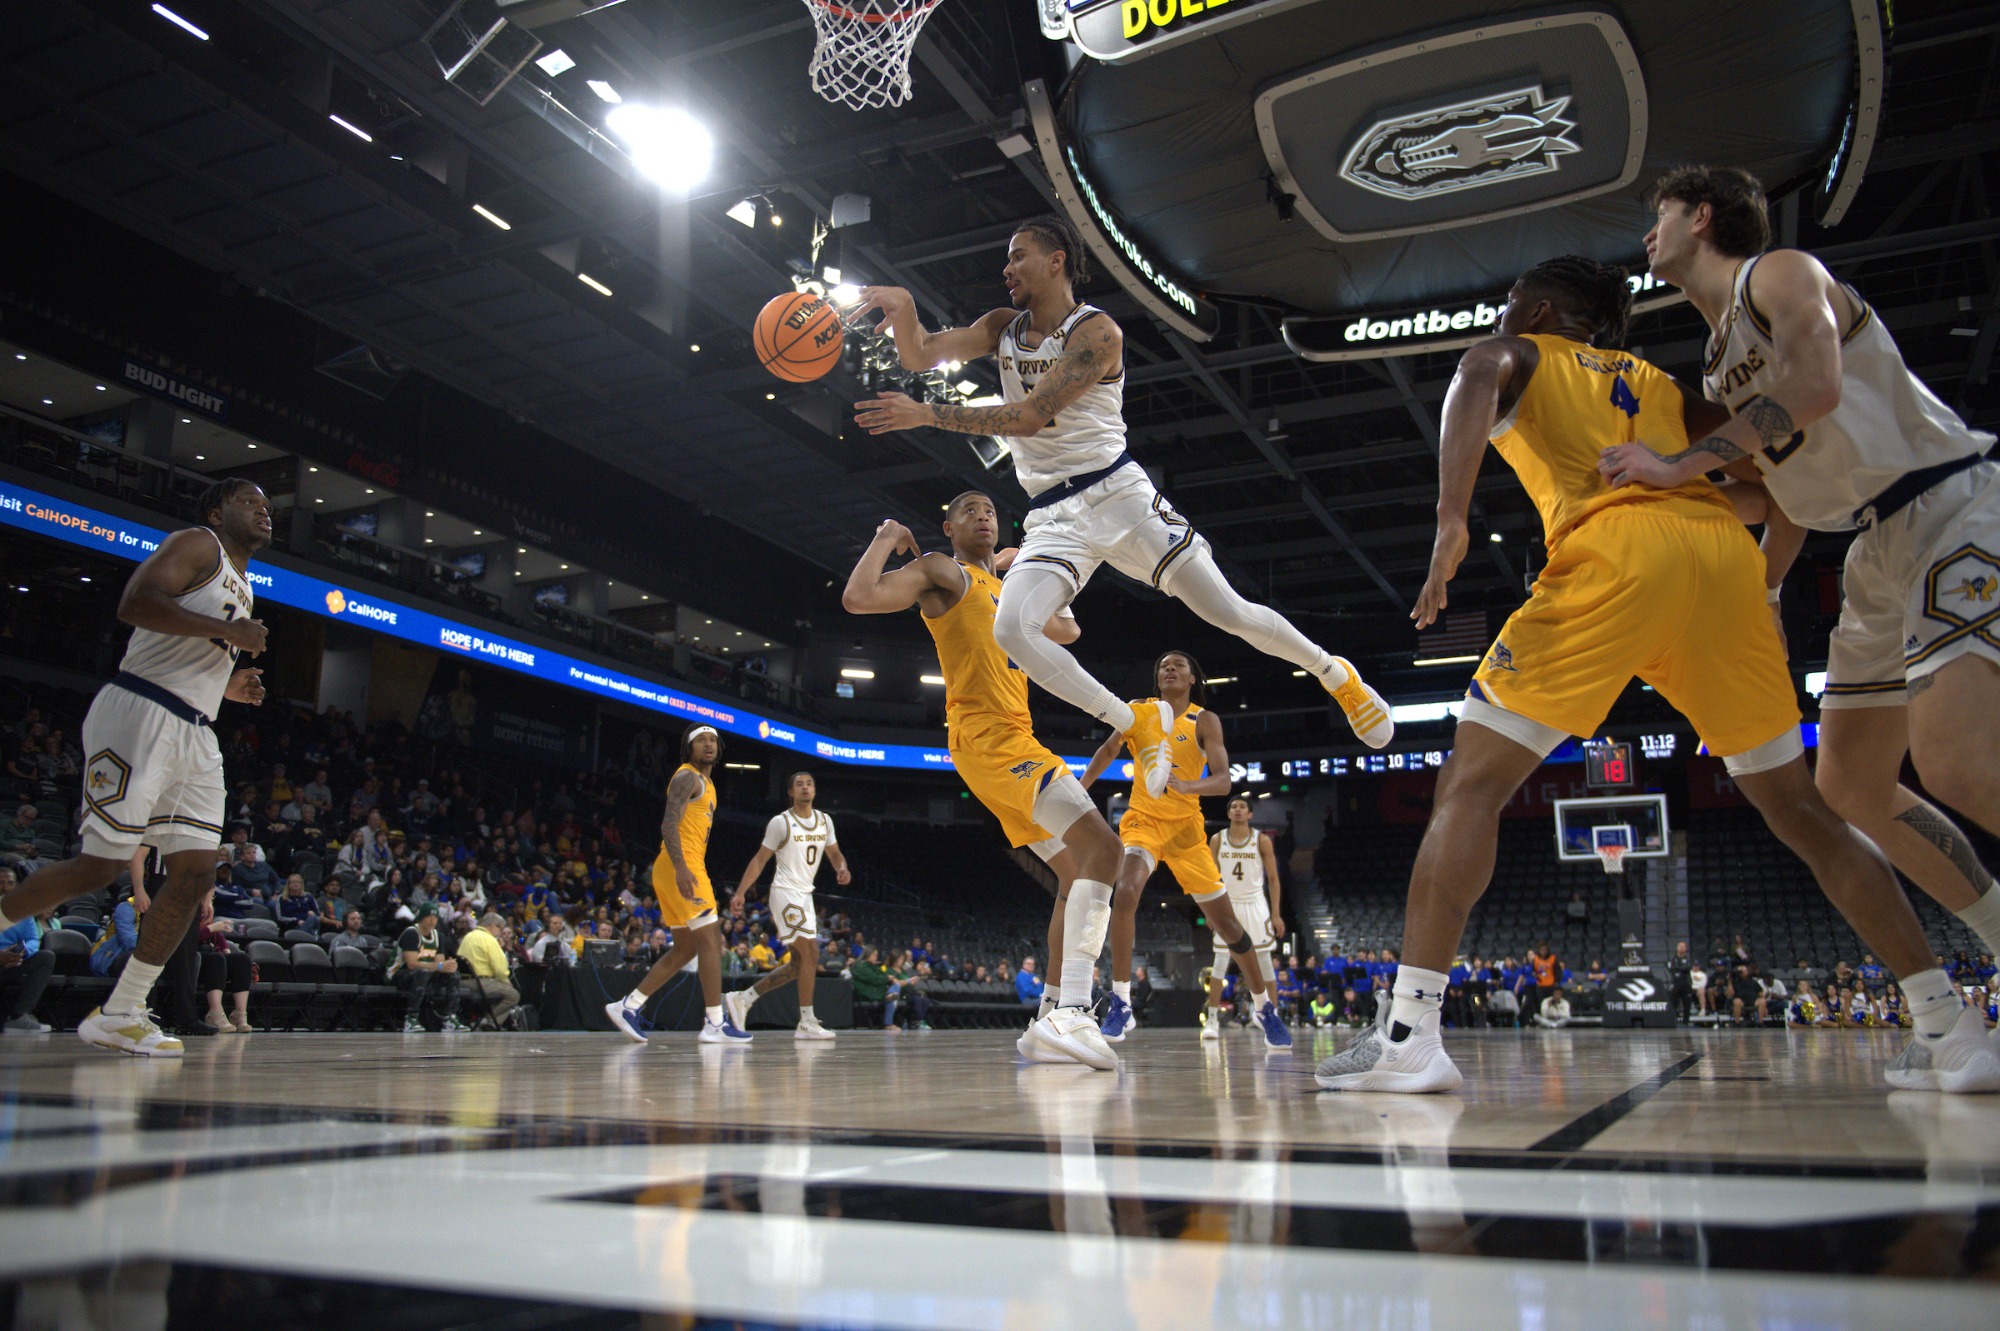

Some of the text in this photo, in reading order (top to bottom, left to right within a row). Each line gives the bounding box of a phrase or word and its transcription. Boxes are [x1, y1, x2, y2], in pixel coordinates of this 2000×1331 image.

[124, 361, 224, 414] BUD LIGHT
[1609, 374, 1641, 420] 4
[0, 494, 22, 513] isit
[25, 503, 116, 542] CalHOPE.org
[118, 531, 139, 547] for
[347, 601, 398, 625] CalHOPE
[440, 628, 535, 667] HOPE PLAYS HERE
[570, 667, 584, 679] For
[583, 672, 608, 687] mental
[608, 678, 630, 693] health
[630, 686, 657, 701] support
[816, 741, 833, 752] HOPE
[857, 749, 885, 761] HERE
[1640, 735, 1676, 751] 11:12
[1320, 759, 1328, 772] 2
[1356, 756, 1365, 770] 4
[1387, 754, 1404, 769] 10
[1424, 751, 1442, 765] 43
[1603, 760, 1625, 782] 18
[793, 834, 827, 843] UC IRVINE
[806, 845, 817, 865] 0
[1231, 852, 1256, 860] IRVINE
[1232, 861, 1244, 881] 4
[1605, 1001, 1669, 1012] THE BIG WEST
